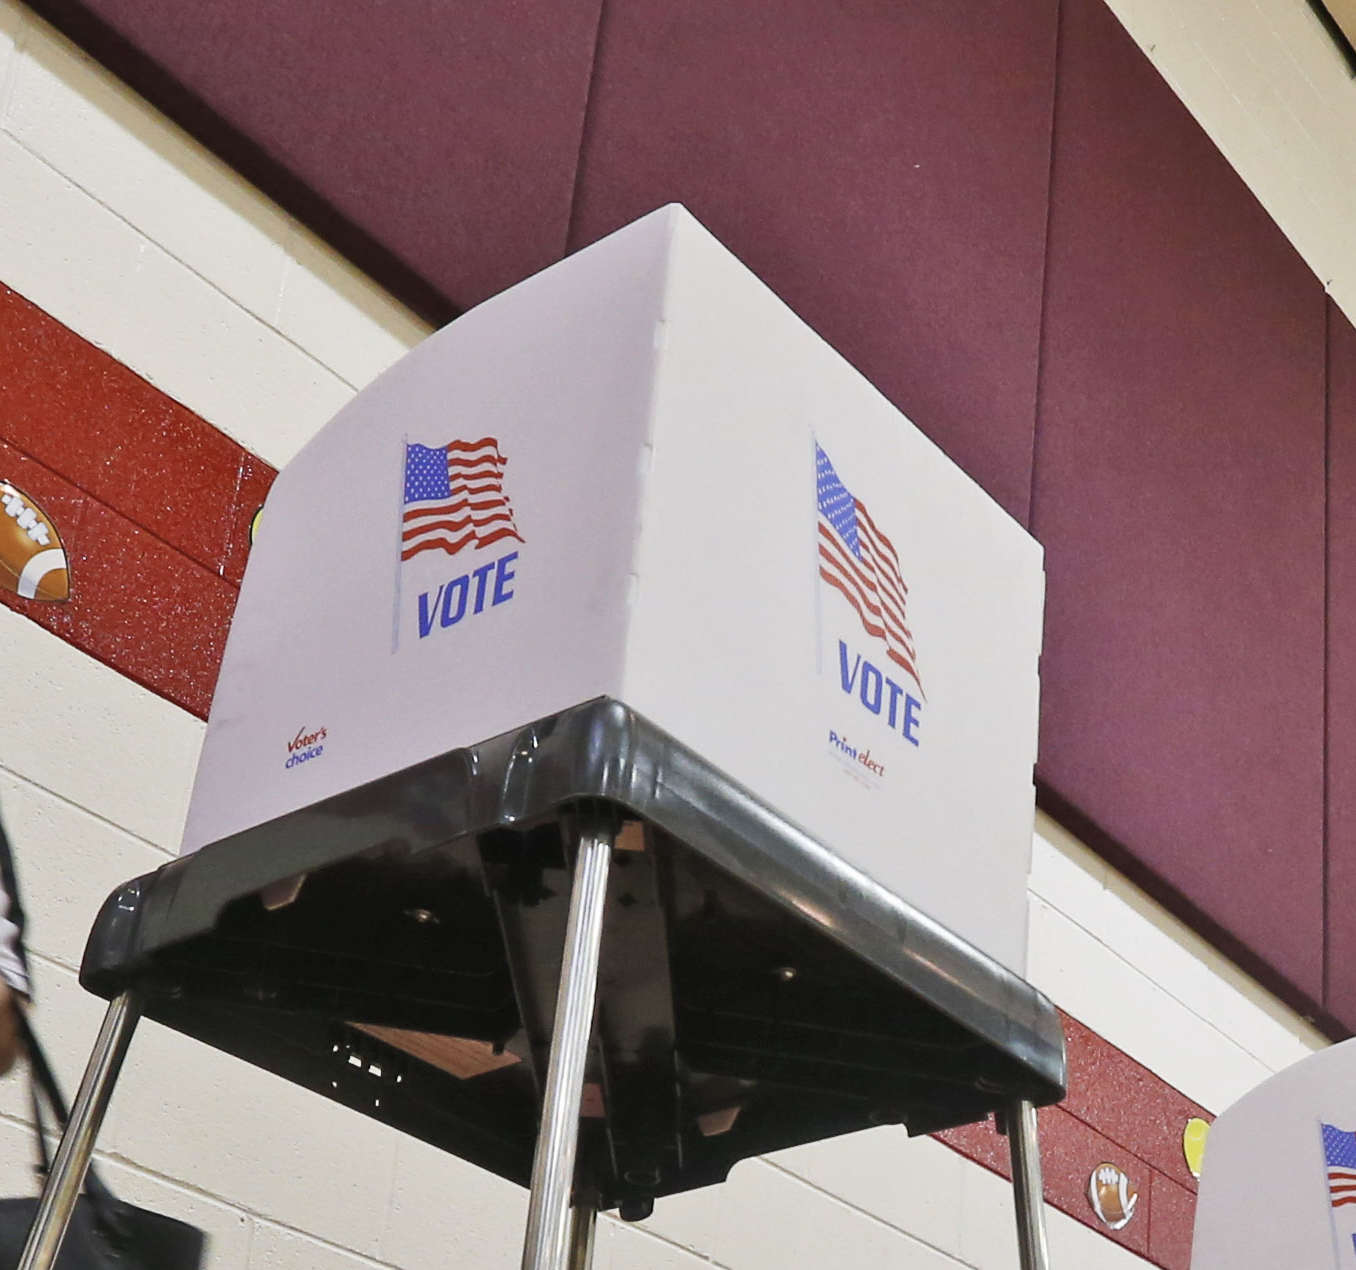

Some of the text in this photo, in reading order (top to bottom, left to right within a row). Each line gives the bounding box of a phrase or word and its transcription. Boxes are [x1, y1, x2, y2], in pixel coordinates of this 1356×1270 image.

[417, 551, 519, 639] VOTE
[838, 638, 923, 748] VOTE
[285, 745, 324, 769] choice
[287, 726, 328, 753] Voter's
